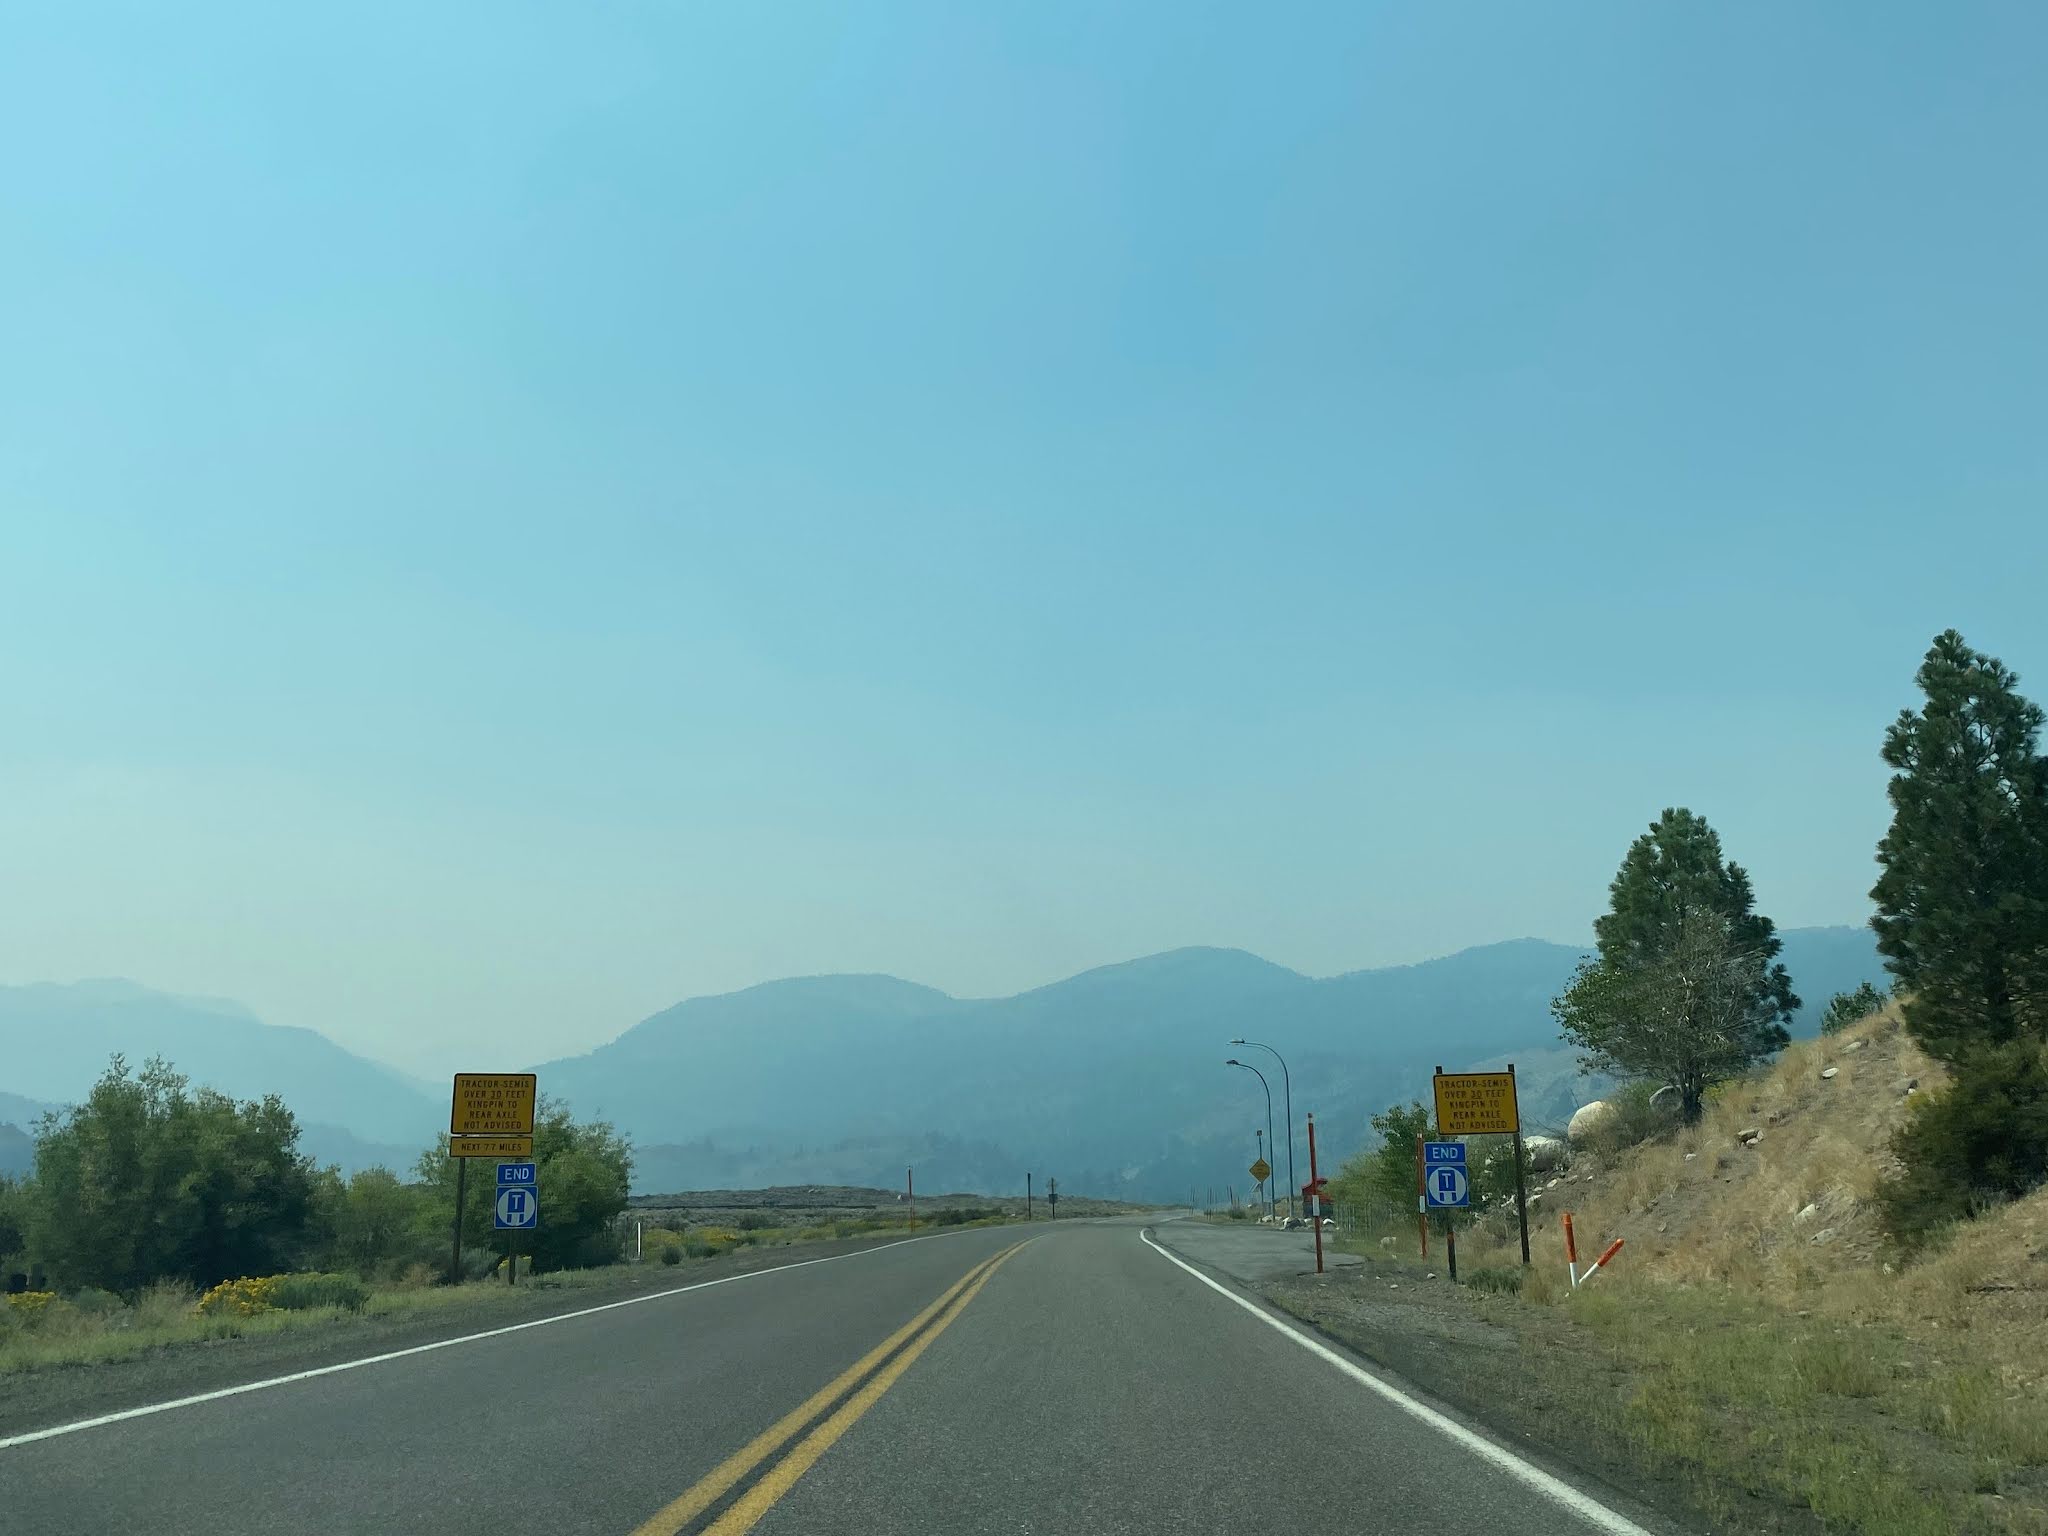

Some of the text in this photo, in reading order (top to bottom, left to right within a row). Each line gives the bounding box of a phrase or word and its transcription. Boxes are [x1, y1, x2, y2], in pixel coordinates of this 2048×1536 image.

[1440, 1079, 1508, 1088] TRACTOR-SEMIS
[1445, 1091, 1466, 1099] OVER
[1472, 1090, 1482, 1099] 30
[1450, 1101, 1485, 1109] KINGPIN
[1432, 1148, 1458, 1159] END
[505, 1168, 529, 1180] END
[1442, 1173, 1451, 1188] T
[512, 1195, 521, 1209] T
